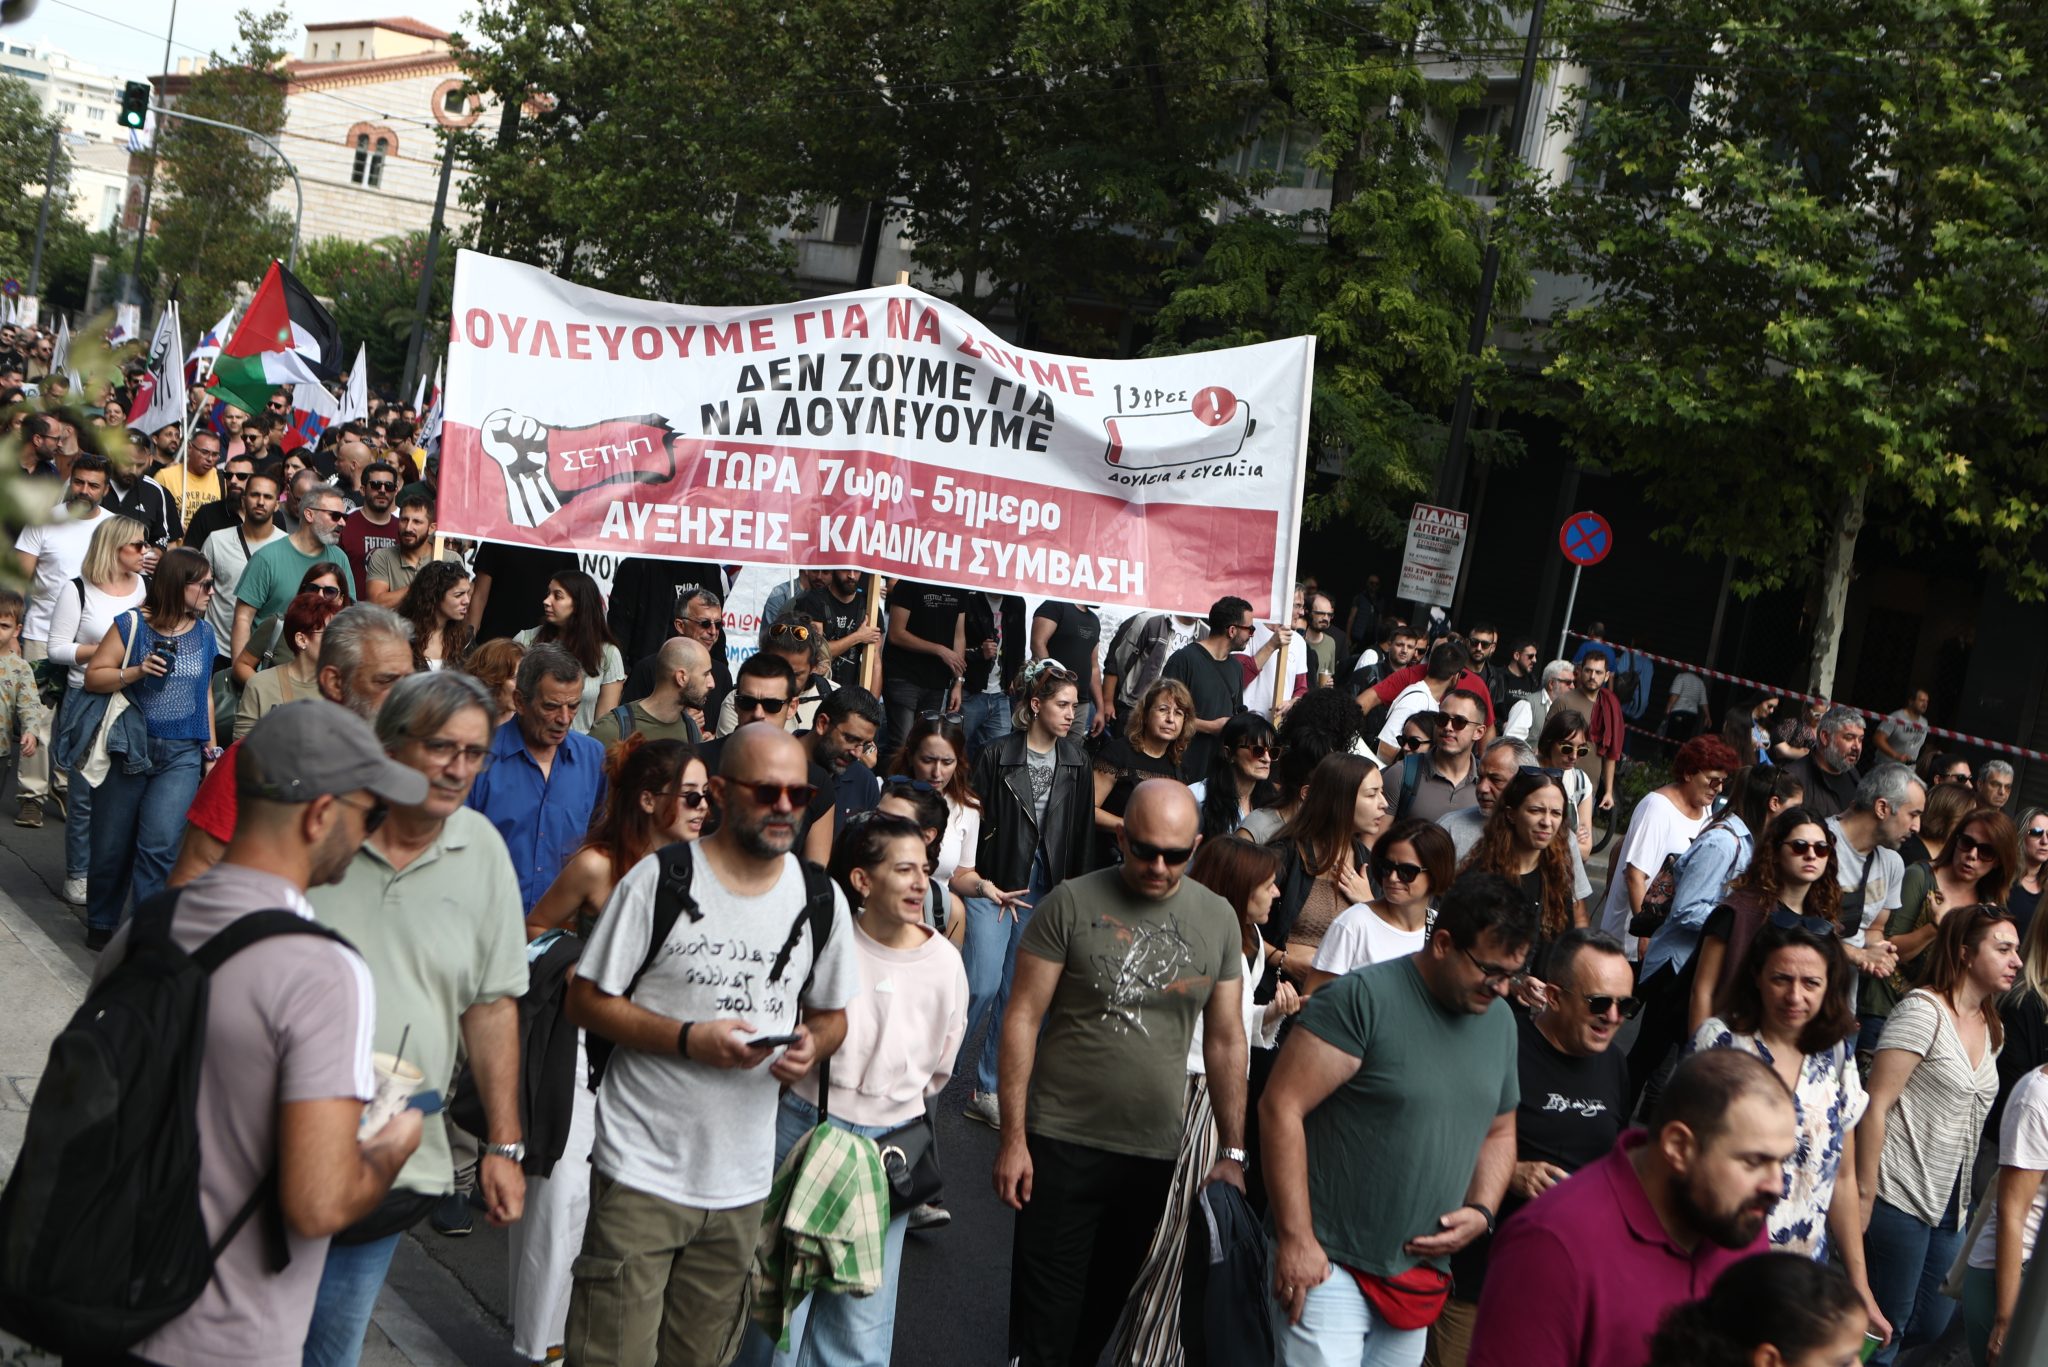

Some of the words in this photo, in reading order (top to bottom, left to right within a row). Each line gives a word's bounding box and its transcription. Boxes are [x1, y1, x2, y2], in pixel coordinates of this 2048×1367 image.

[794, 303, 869, 345] ΓΙΑ
[887, 297, 941, 345] ΝΑ
[736, 353, 825, 393] ΔΕΝ
[838, 351, 974, 402] ΖΟΥΜΕ
[987, 376, 1056, 423] ΓΙΑ
[700, 397, 762, 436] ΝΑ
[775, 396, 1055, 453] ΔΟΥΛΕΥΟΥΜΕ
[560, 437, 653, 472] ΣΕΤΗΠ
[1176, 469, 1187, 480] &
[704, 450, 801, 495] ΤΩΡΑ
[818, 458, 902, 509] 7ωρο
[932, 474, 1061, 536] 5ημερο
[1415, 507, 1465, 528] ΠΑΜΕ
[1415, 521, 1460, 540] ΑΠΕΡΓΙΑ
[819, 514, 960, 571] ΚΛΑΔΙΚΗ
[967, 538, 1144, 596] ΣΥΜΒΑΣΗ
